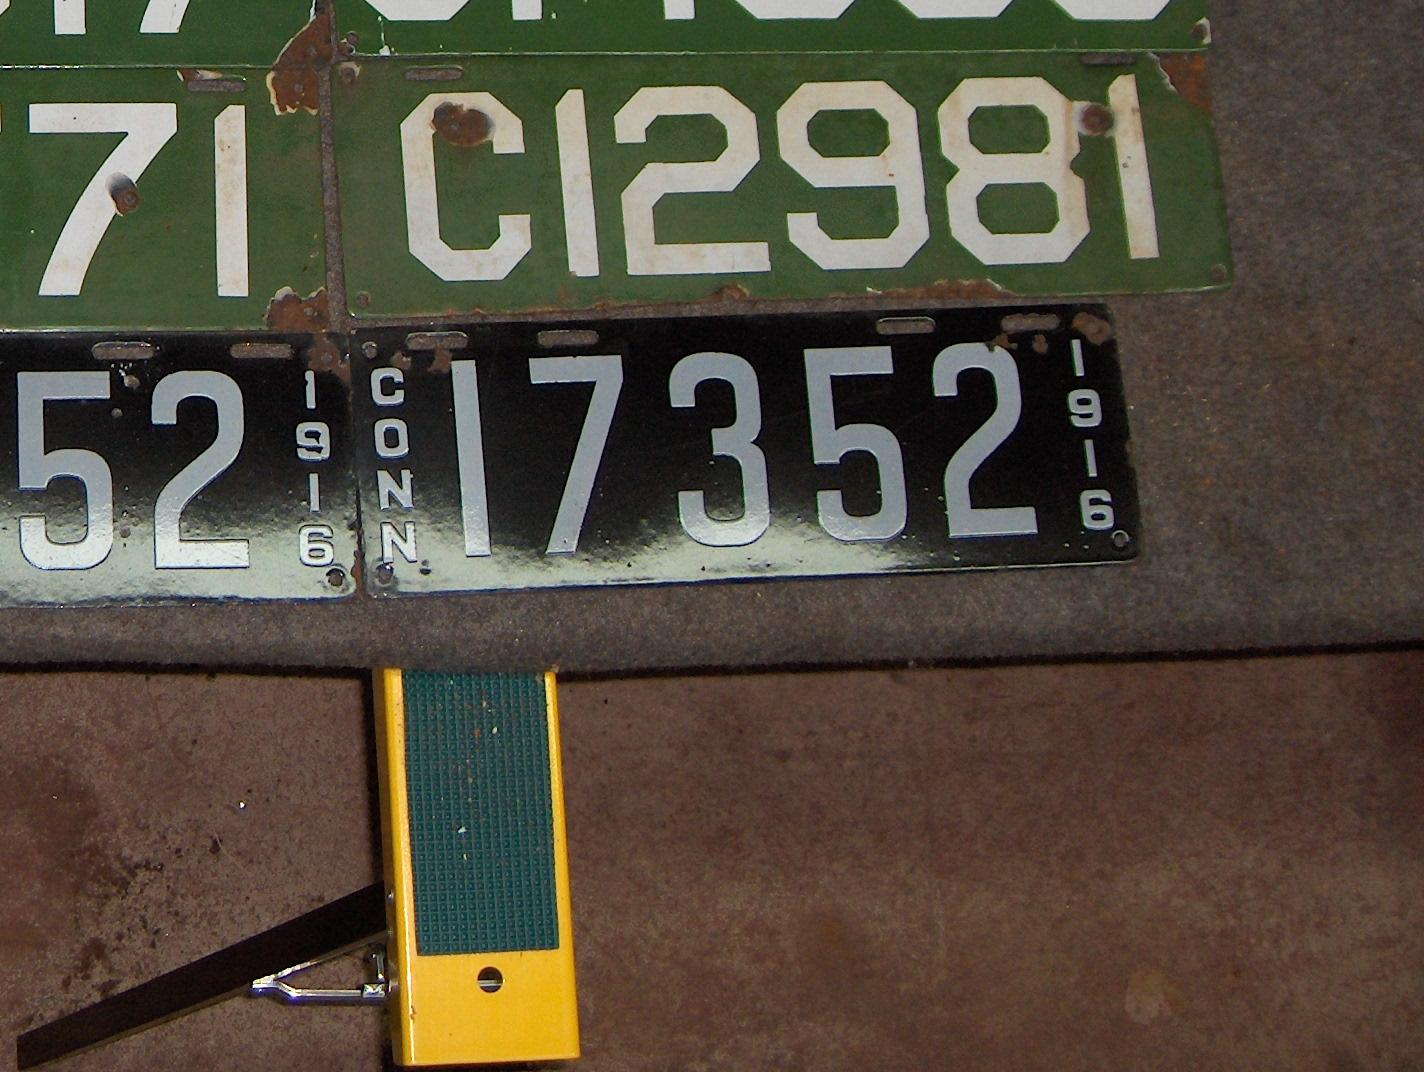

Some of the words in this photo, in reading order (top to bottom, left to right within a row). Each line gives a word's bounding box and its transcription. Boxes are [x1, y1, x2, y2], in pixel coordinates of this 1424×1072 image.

[399, 74, 1160, 282] C12981
[296, 370, 335, 569] 1916
[370, 368, 418, 565] CONN
[451, 342, 1039, 557] 17352
[1067, 339, 1116, 531] 1916
